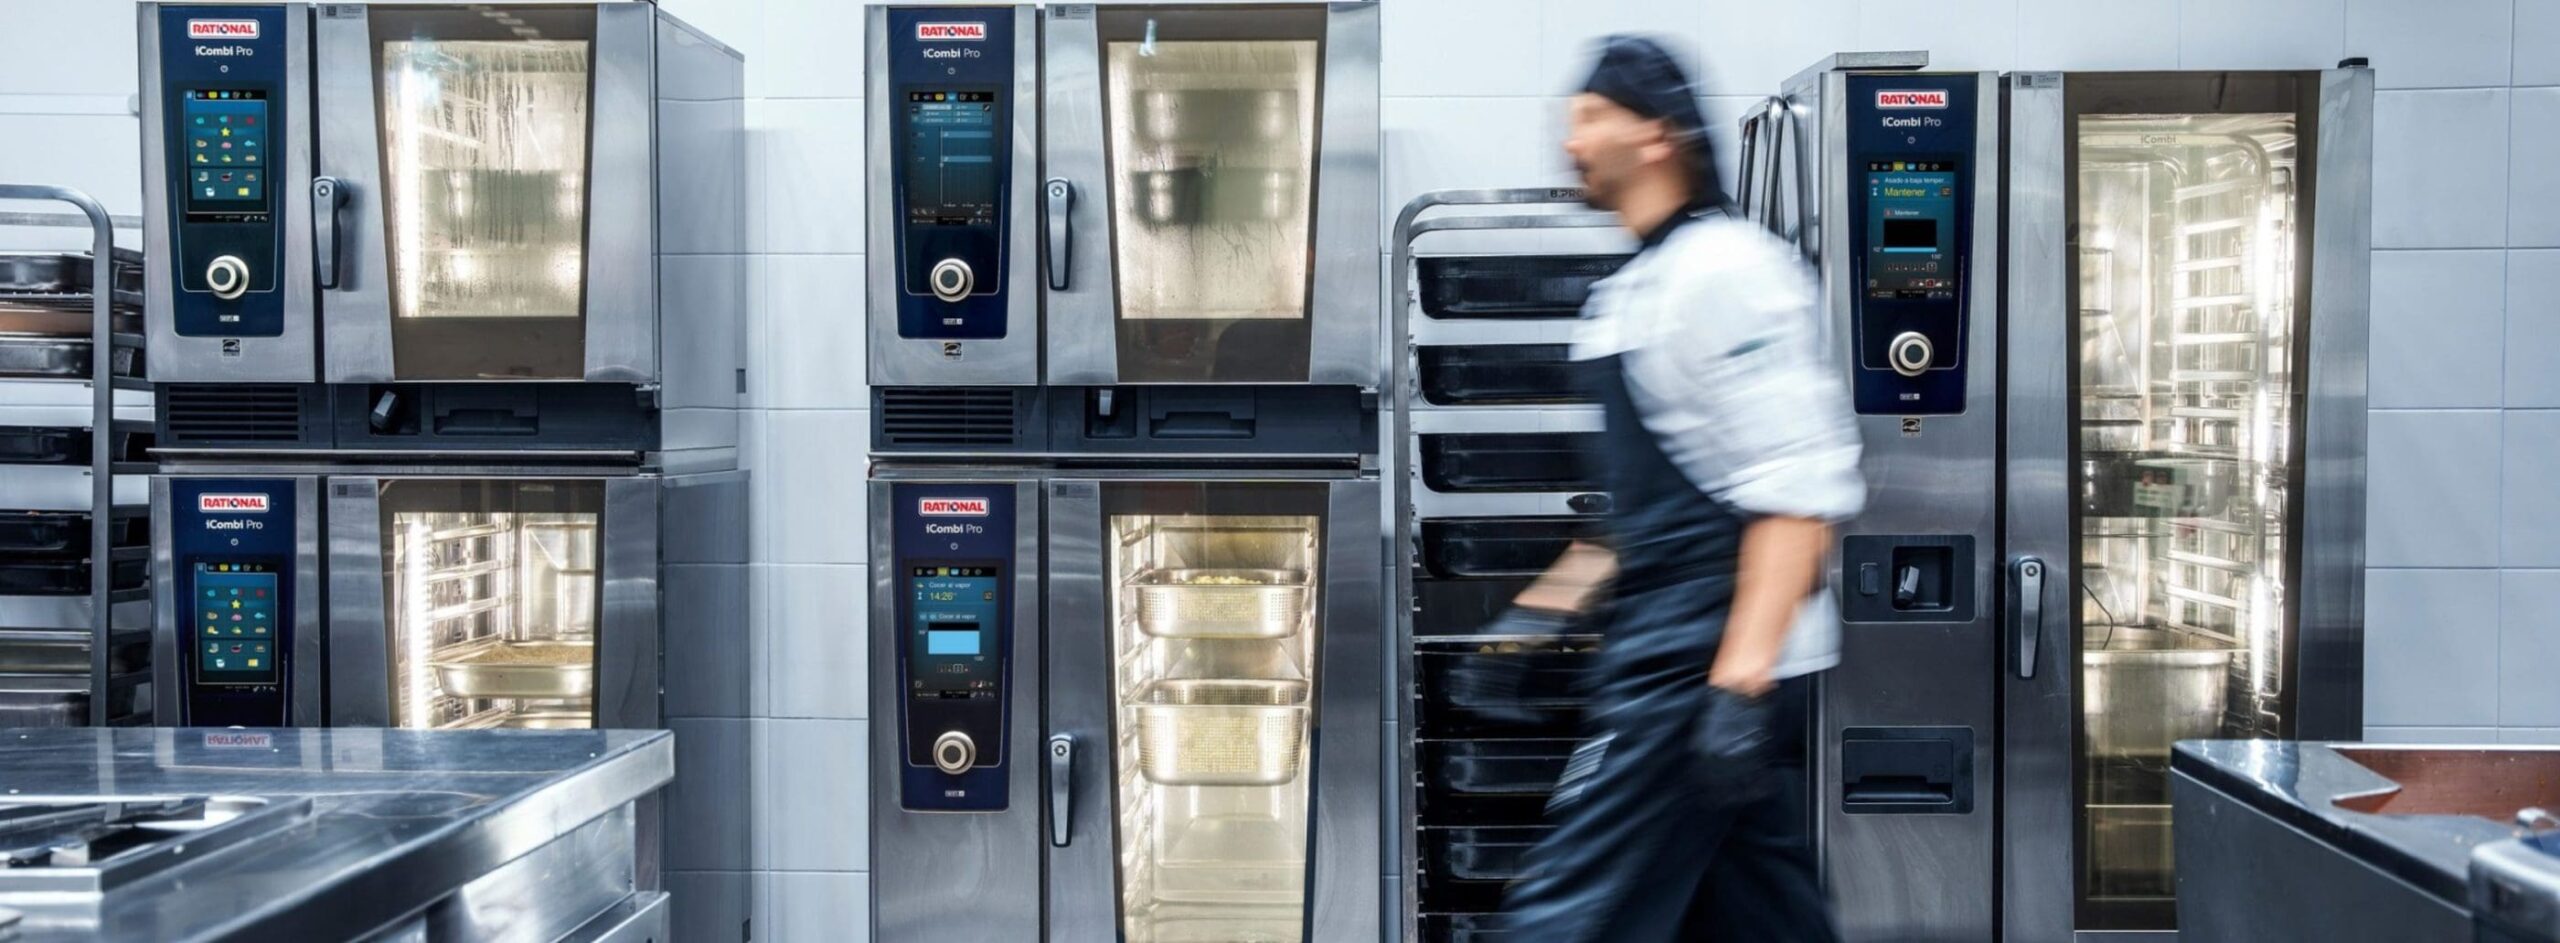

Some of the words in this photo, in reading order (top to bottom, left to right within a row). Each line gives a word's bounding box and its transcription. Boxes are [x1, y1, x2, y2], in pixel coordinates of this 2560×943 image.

[192, 23, 255, 34] RATIONAL
[920, 25, 983, 37] RATIONAL
[195, 45, 234, 56] iCombi
[236, 46, 254, 56] Pro
[922, 48, 961, 58] iCombi
[963, 48, 981, 58] Pro
[1880, 94, 1944, 105] RATIONAL
[1882, 117, 1921, 127] iCombi
[1924, 117, 1942, 127] Pro
[2140, 135, 2176, 144] iCombi
[1884, 187, 1926, 197] Mantener
[203, 497, 265, 508] RATIONAL
[923, 501, 985, 512] RATIONAL
[206, 519, 244, 530] iCombi
[246, 520, 264, 530] Pro
[926, 523, 964, 534] iCombi
[966, 524, 983, 534] Pro
